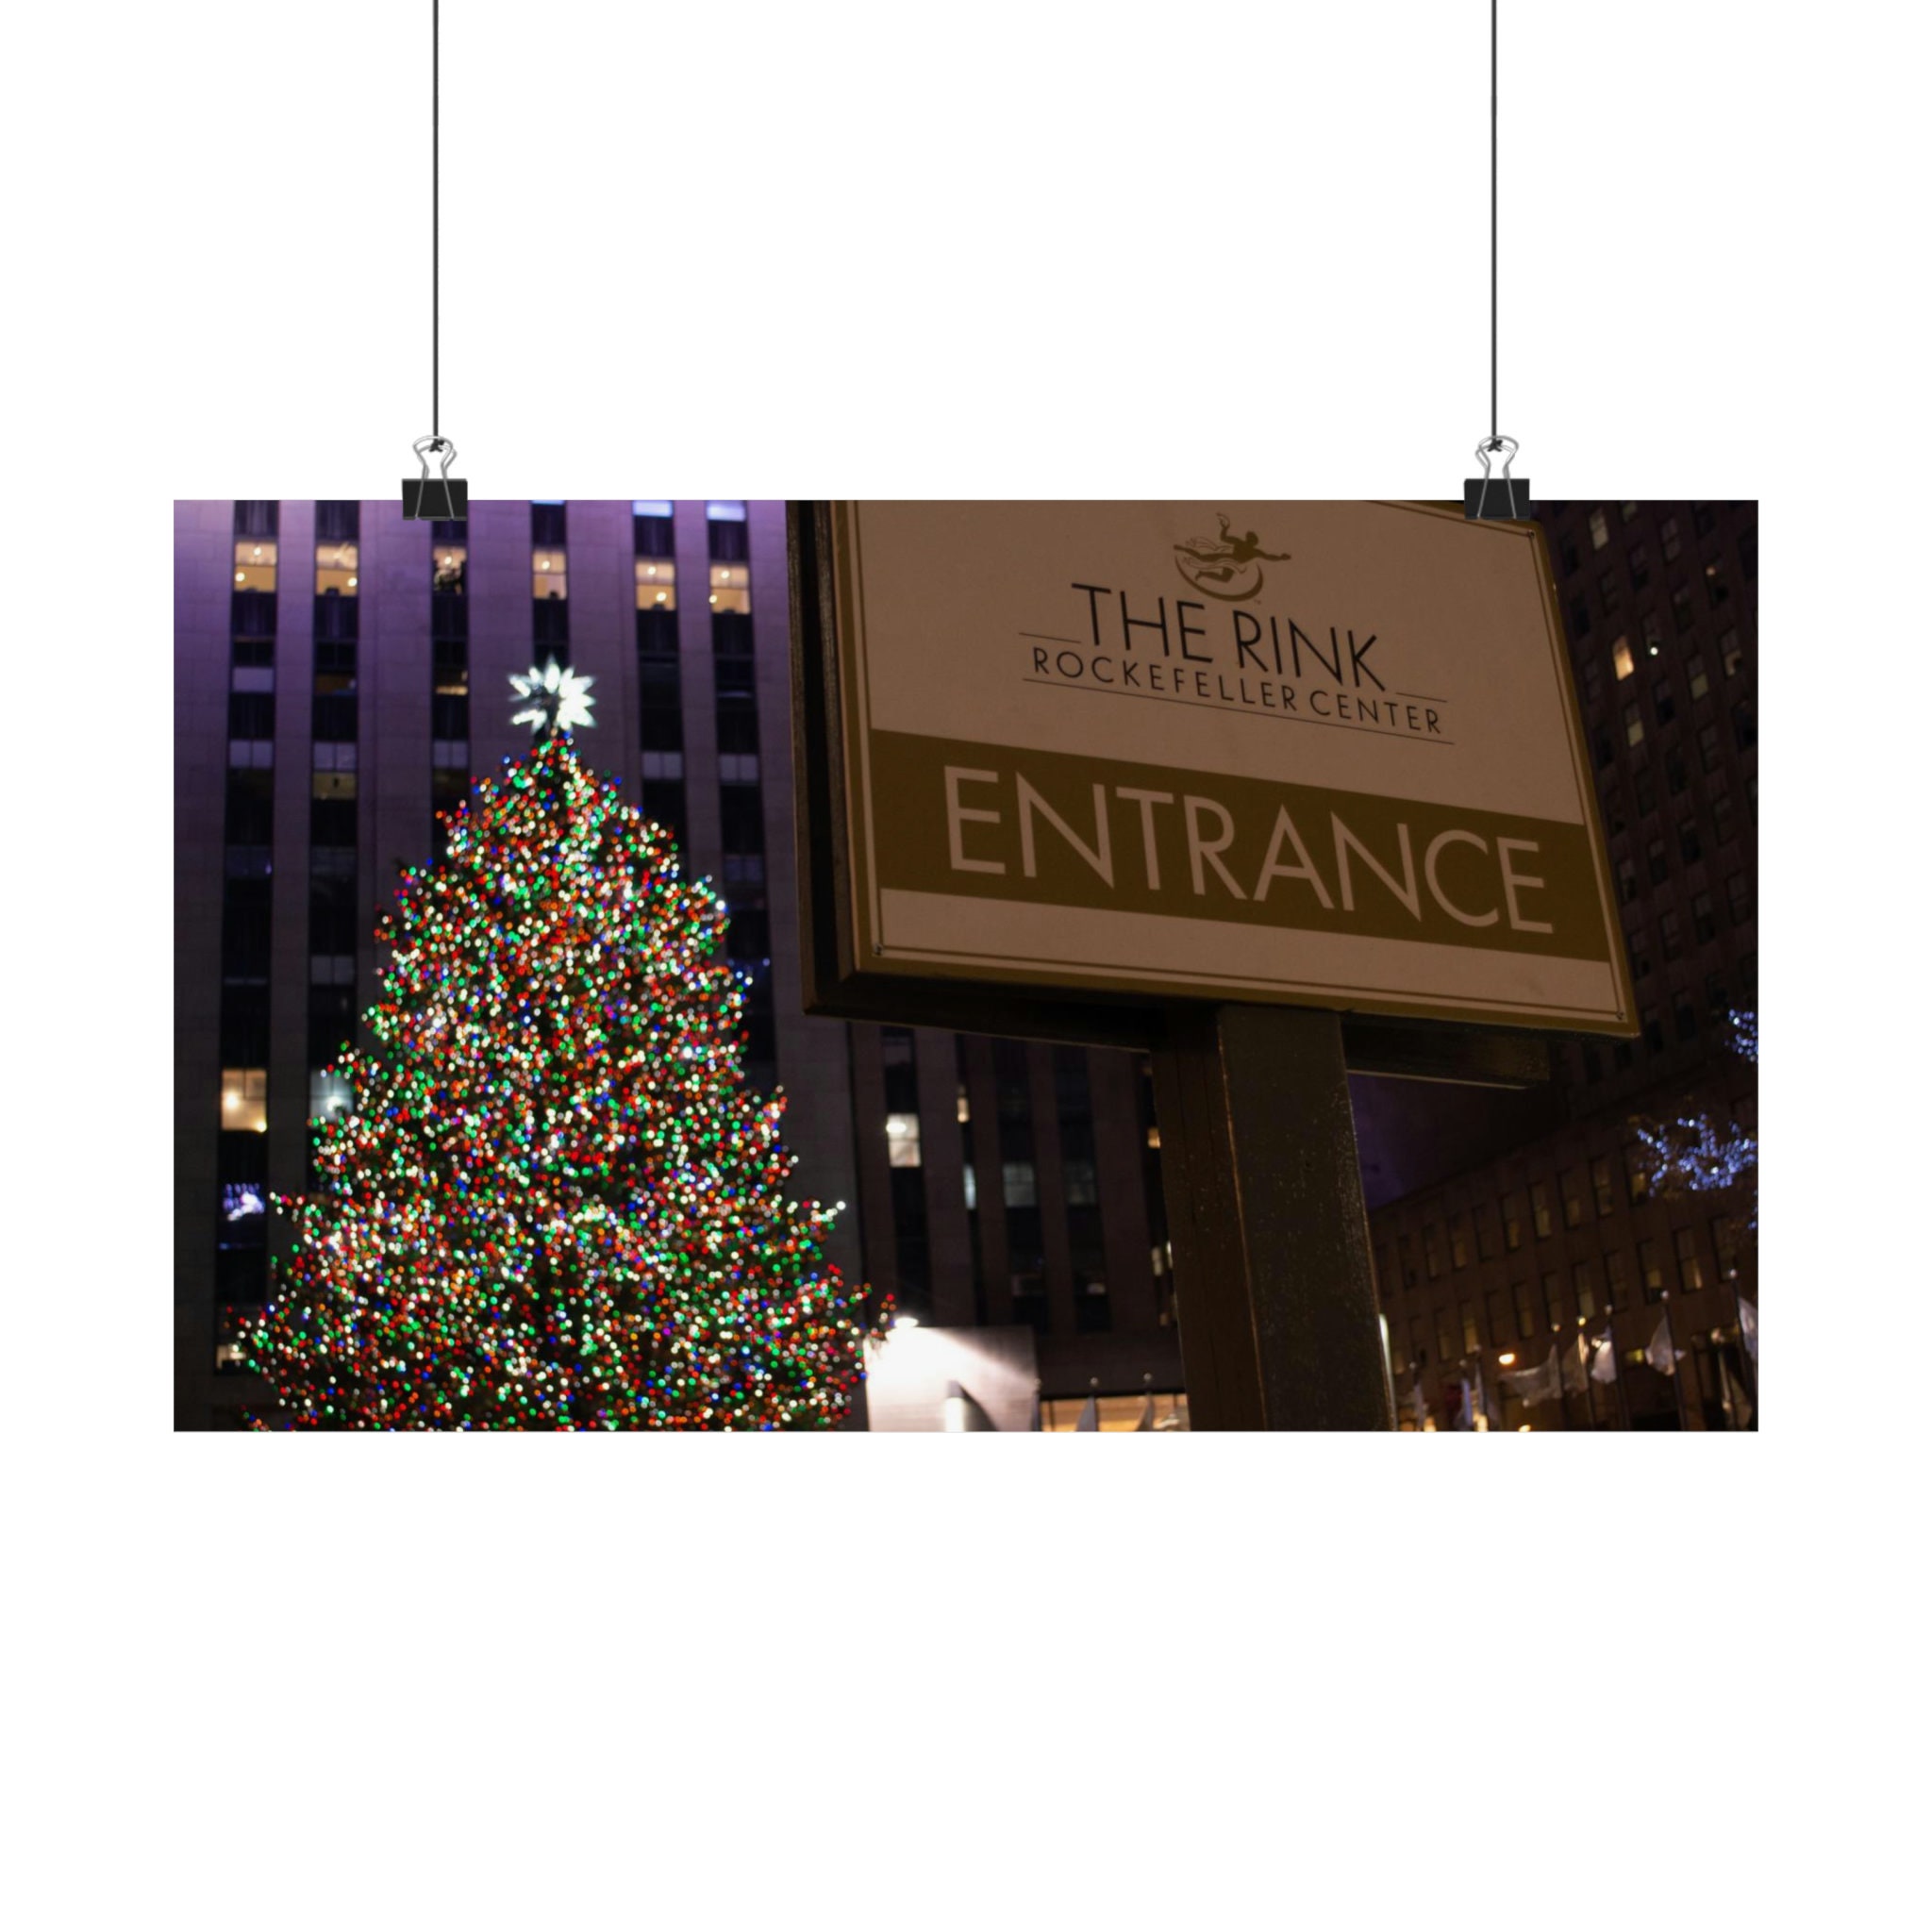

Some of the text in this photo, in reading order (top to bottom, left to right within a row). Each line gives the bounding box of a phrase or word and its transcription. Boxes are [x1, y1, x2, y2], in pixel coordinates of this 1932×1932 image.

[1032, 646, 1442, 735] ROCKEFELLER CENTER
[1071, 582, 1386, 692] THE RINK
[943, 765, 1554, 935] ENTRANCE
